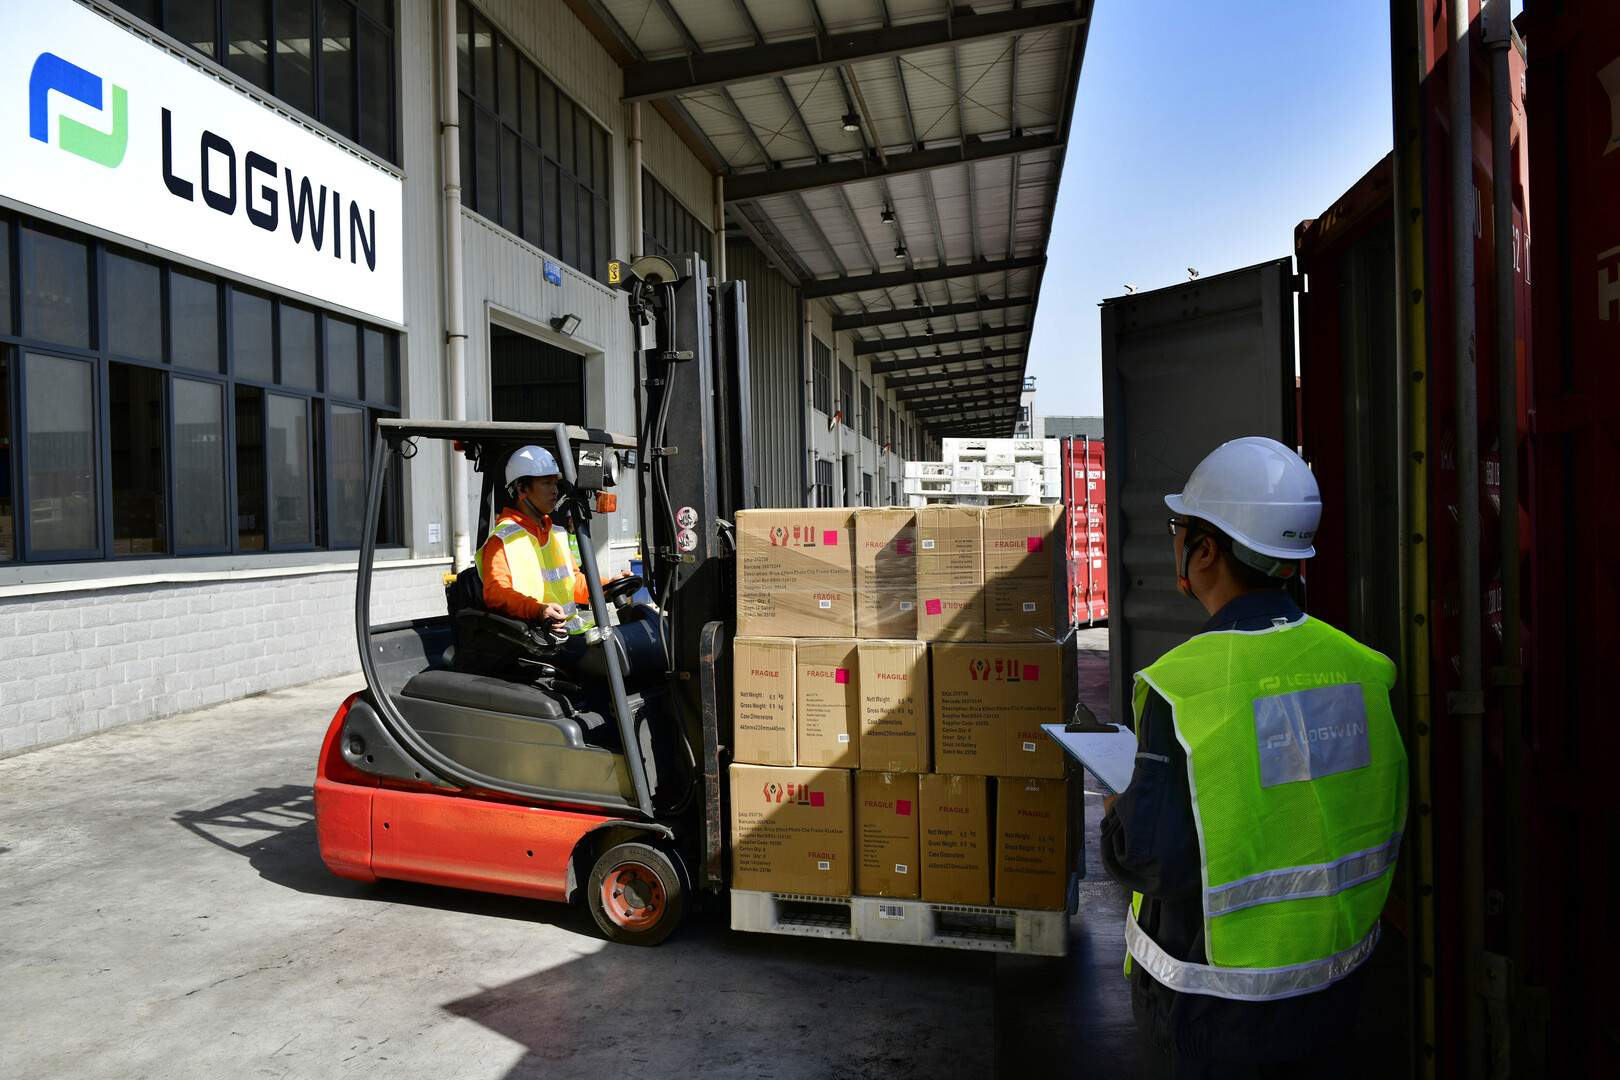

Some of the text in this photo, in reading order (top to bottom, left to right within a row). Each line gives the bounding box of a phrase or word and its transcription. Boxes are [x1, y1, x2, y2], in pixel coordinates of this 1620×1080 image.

[162, 106, 376, 272] LOGWIN
[1286, 672, 1346, 686] LOGWIN
[1018, 732, 1048, 740] FRAGILE
[1300, 722, 1364, 744] LOGWIN
[1018, 810, 1049, 818] FRAGILE
[808, 852, 836, 860] FRAGILE
